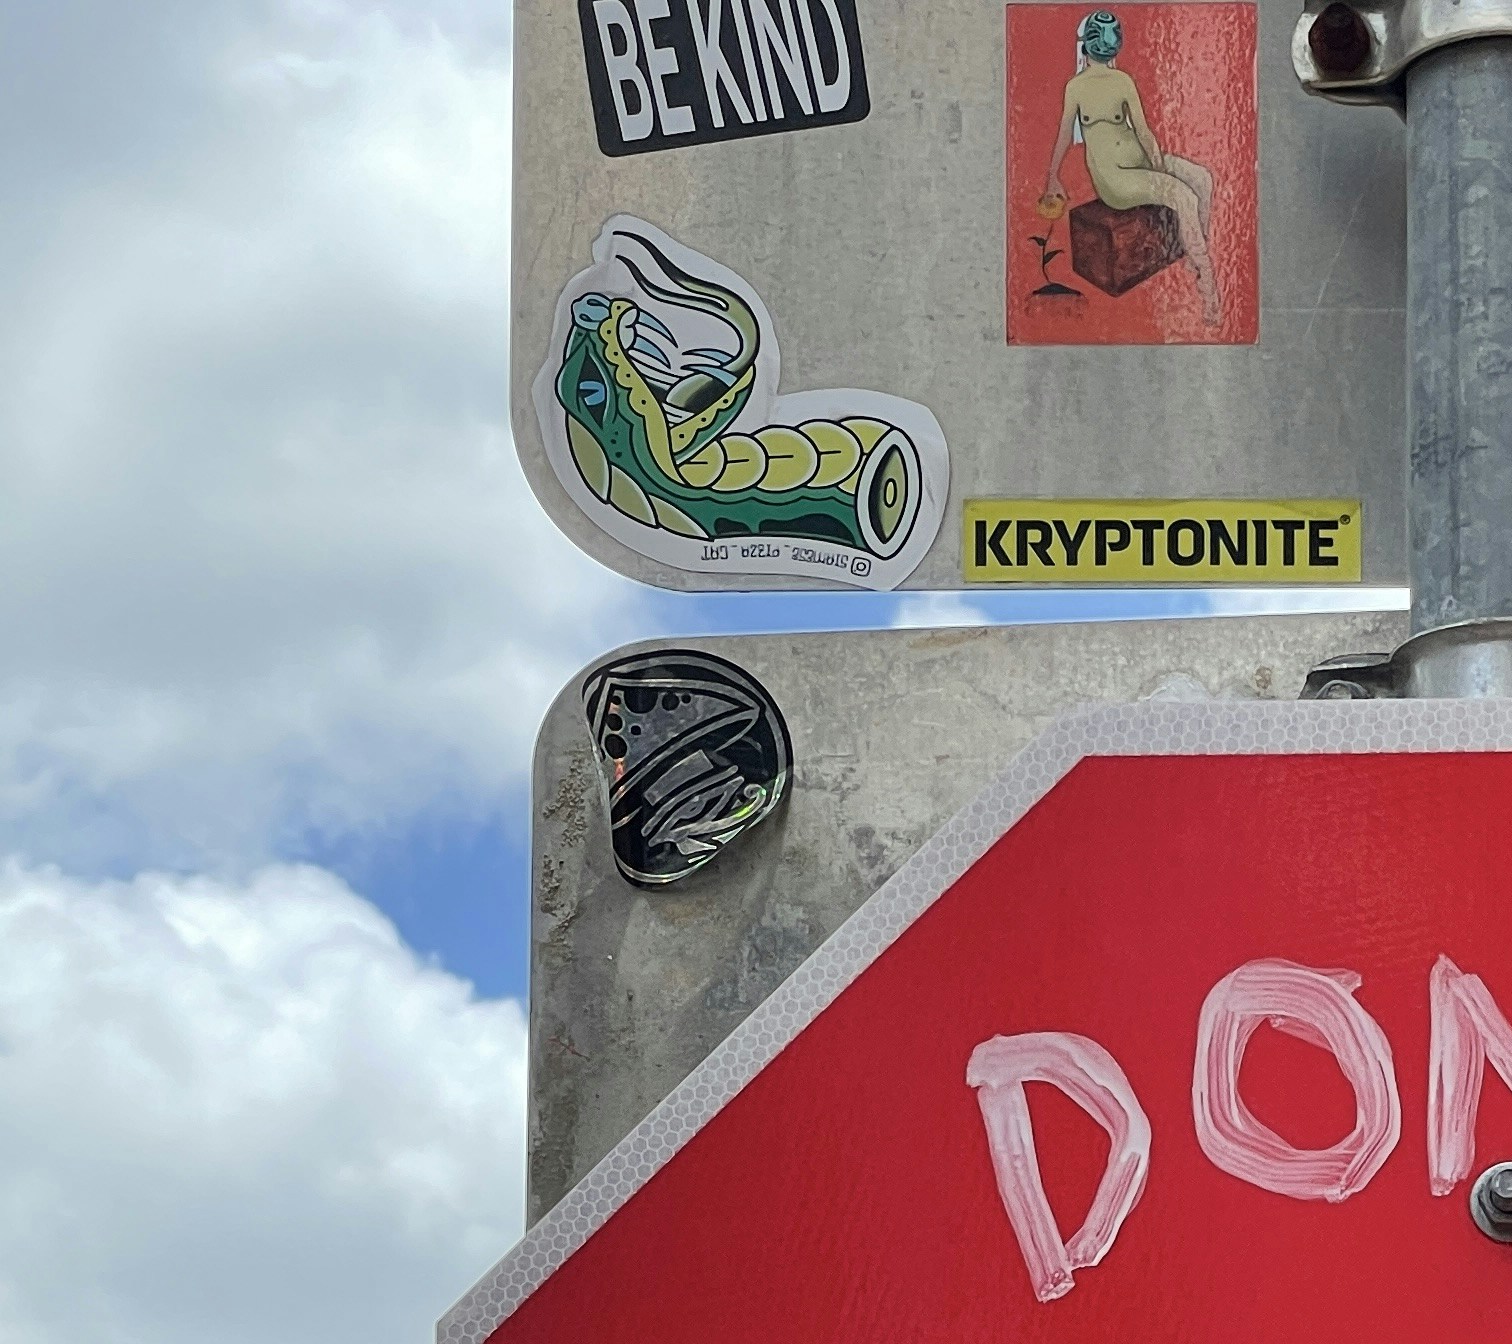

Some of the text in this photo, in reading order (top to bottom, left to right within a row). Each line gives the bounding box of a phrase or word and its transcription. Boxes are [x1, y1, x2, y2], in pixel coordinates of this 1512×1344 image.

[593, 0, 850, 141] BE KIND
[975, 518, 1339, 567] KRYPTONITE
